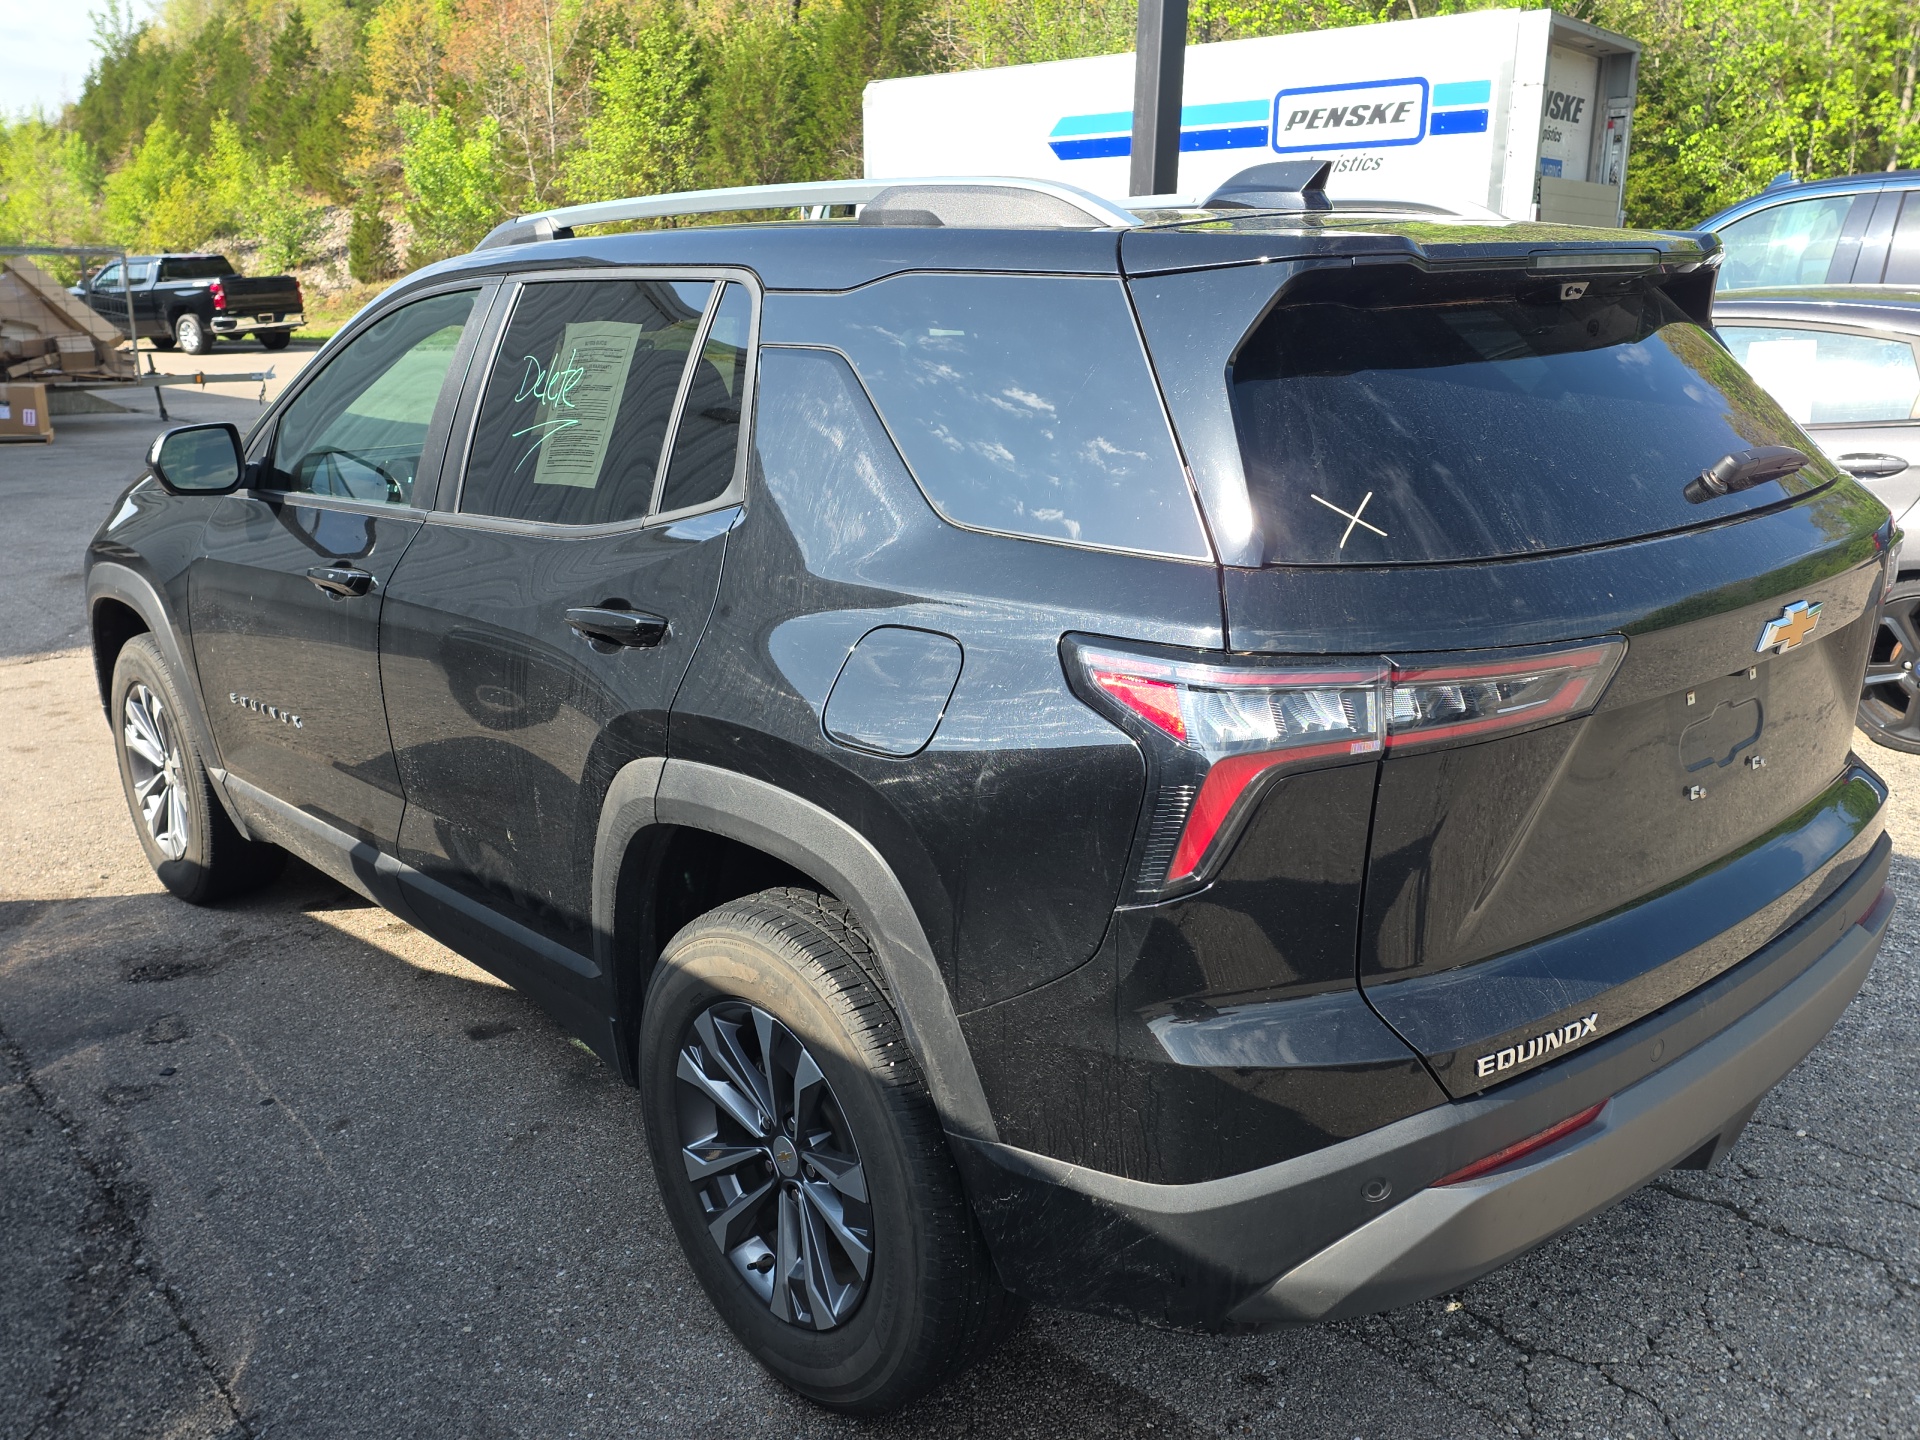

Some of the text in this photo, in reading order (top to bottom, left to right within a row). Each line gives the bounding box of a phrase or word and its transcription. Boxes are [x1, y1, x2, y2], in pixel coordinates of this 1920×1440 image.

[1285, 100, 1414, 131] PENSKE
[1311, 152, 1384, 173] istics
[514, 348, 584, 408] Delete
[229, 692, 303, 729] EQUINOX
[1475, 1011, 1599, 1078] EQUINOX
